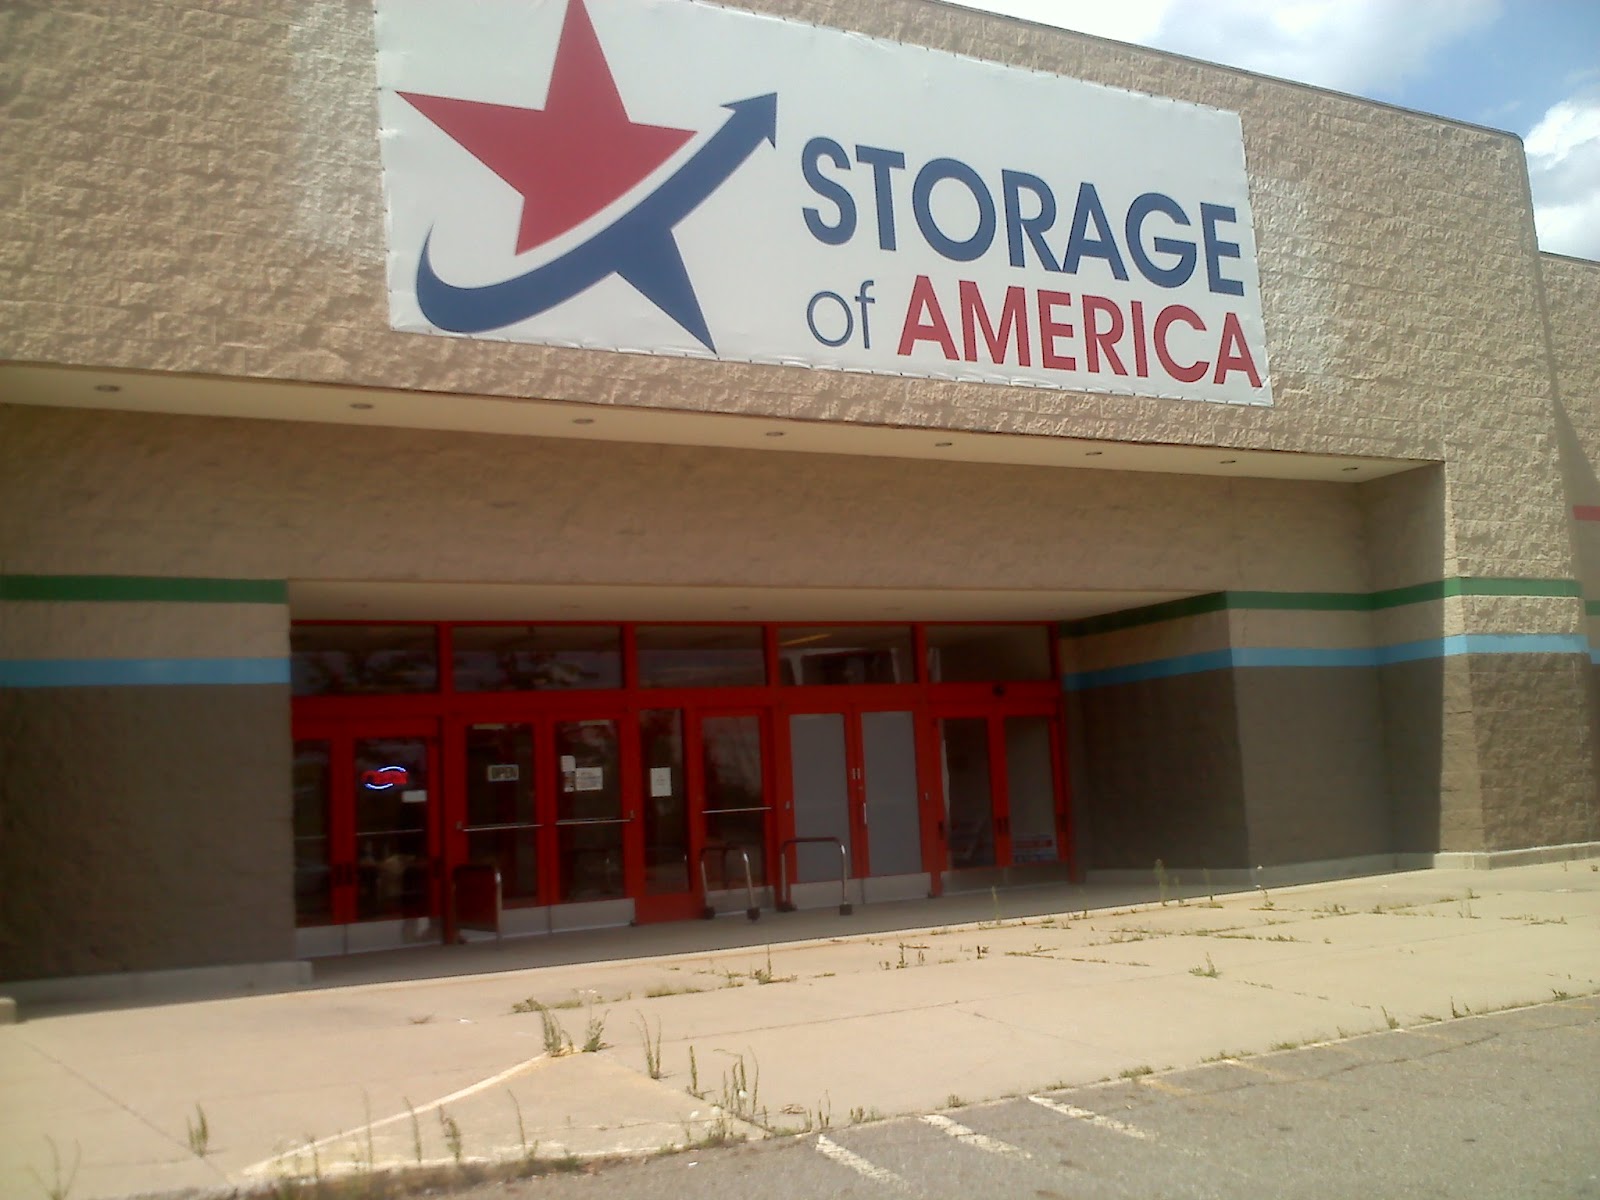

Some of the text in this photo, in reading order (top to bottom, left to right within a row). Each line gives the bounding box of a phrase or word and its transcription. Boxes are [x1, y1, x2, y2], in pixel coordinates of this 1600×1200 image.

[802, 137, 1244, 296] STORAGE
[806, 275, 1262, 388] of AMERICA
